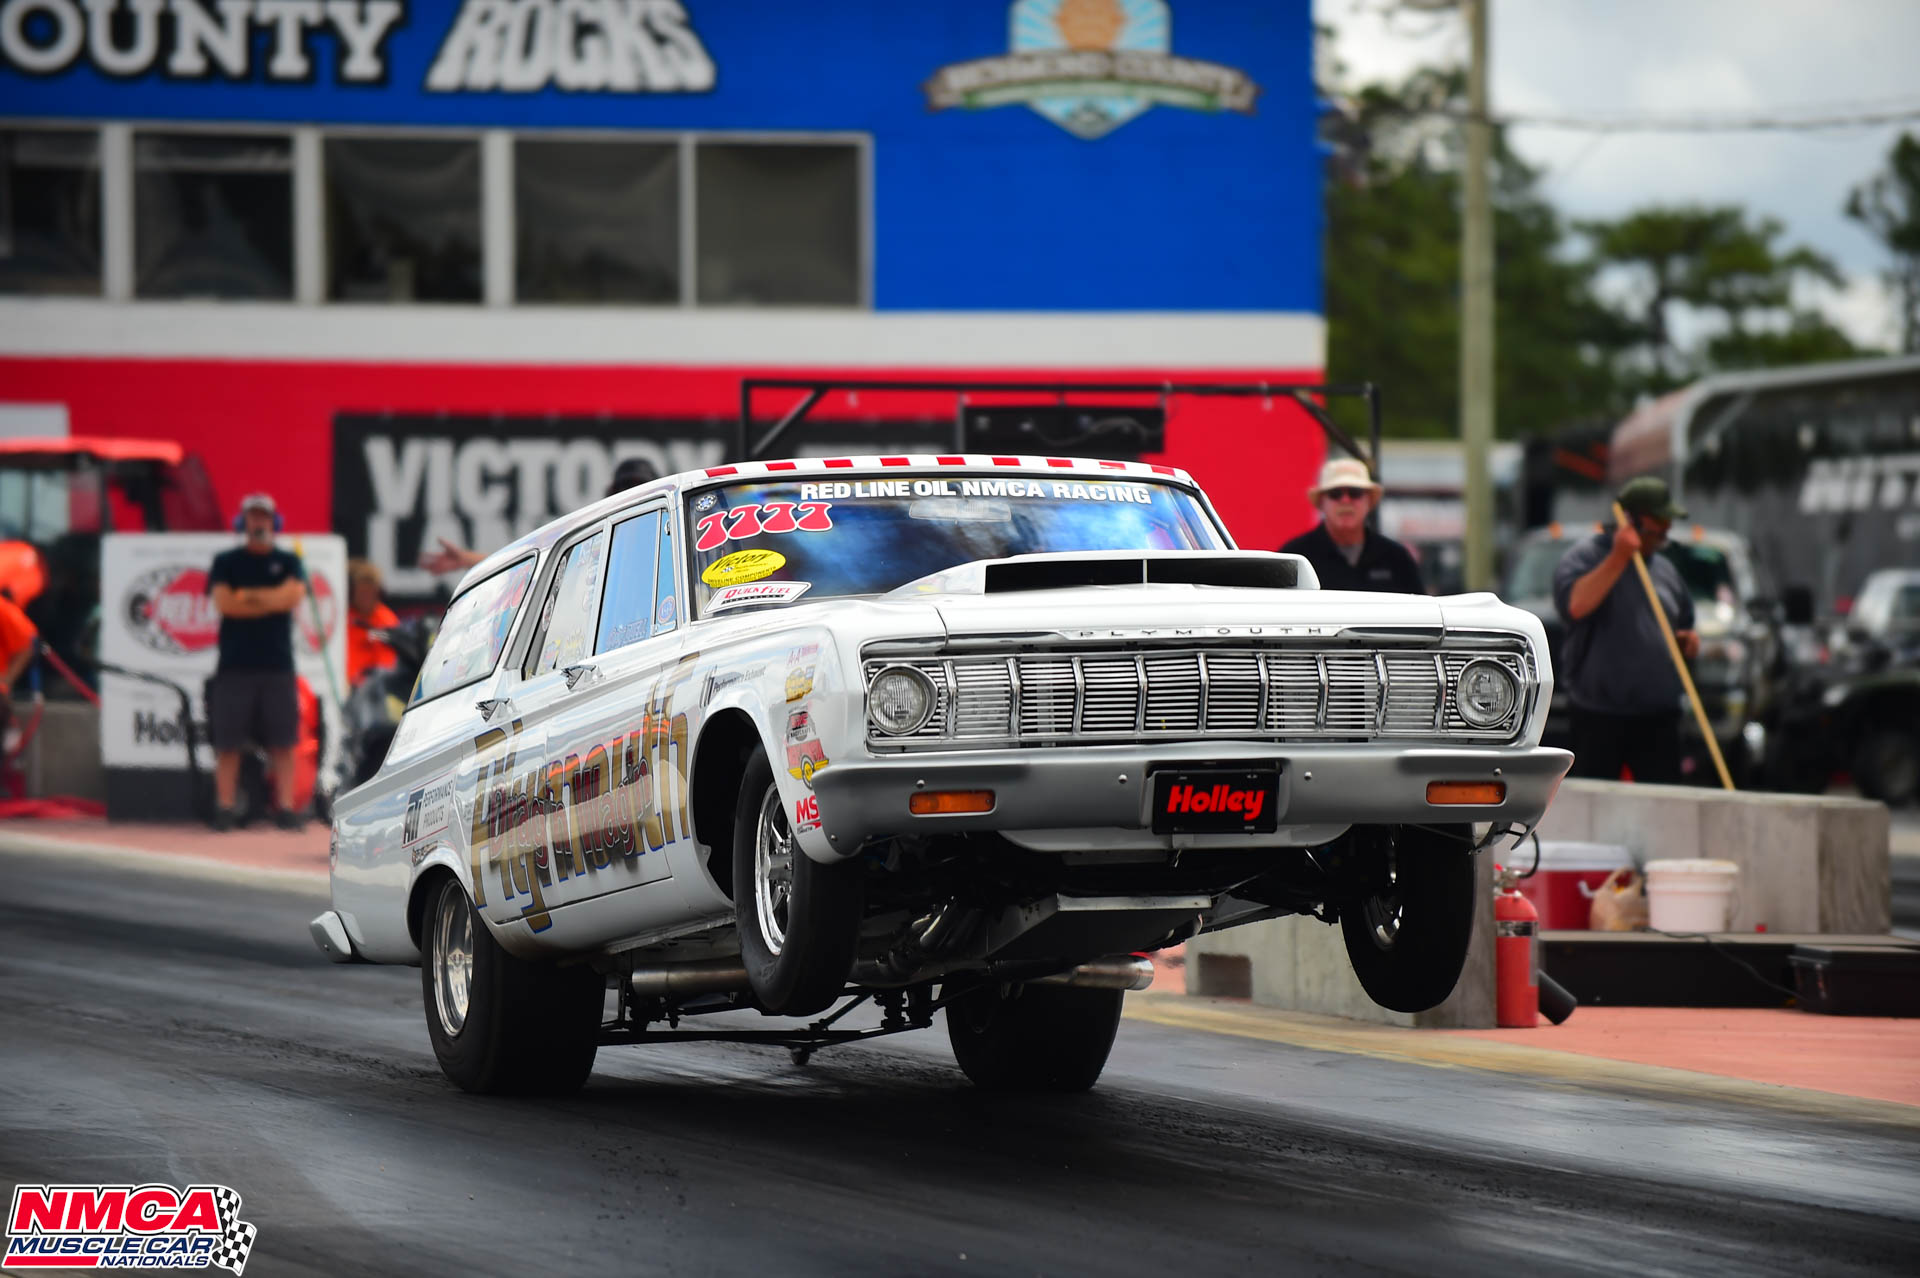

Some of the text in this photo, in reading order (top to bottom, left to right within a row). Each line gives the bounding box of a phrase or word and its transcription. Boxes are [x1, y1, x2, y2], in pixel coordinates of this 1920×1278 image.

[0, 0, 401, 80] OUNTY
[425, 0, 717, 92] ROCKS
[801, 480, 1153, 504] RED LINE OIL NMCA RACING
[696, 502, 833, 551] 7777
[712, 552, 775, 572] Victory
[1079, 626, 1322, 637] PLYMOUTH
[470, 650, 700, 935] Plymouth
[1167, 784, 1268, 821] Holley
